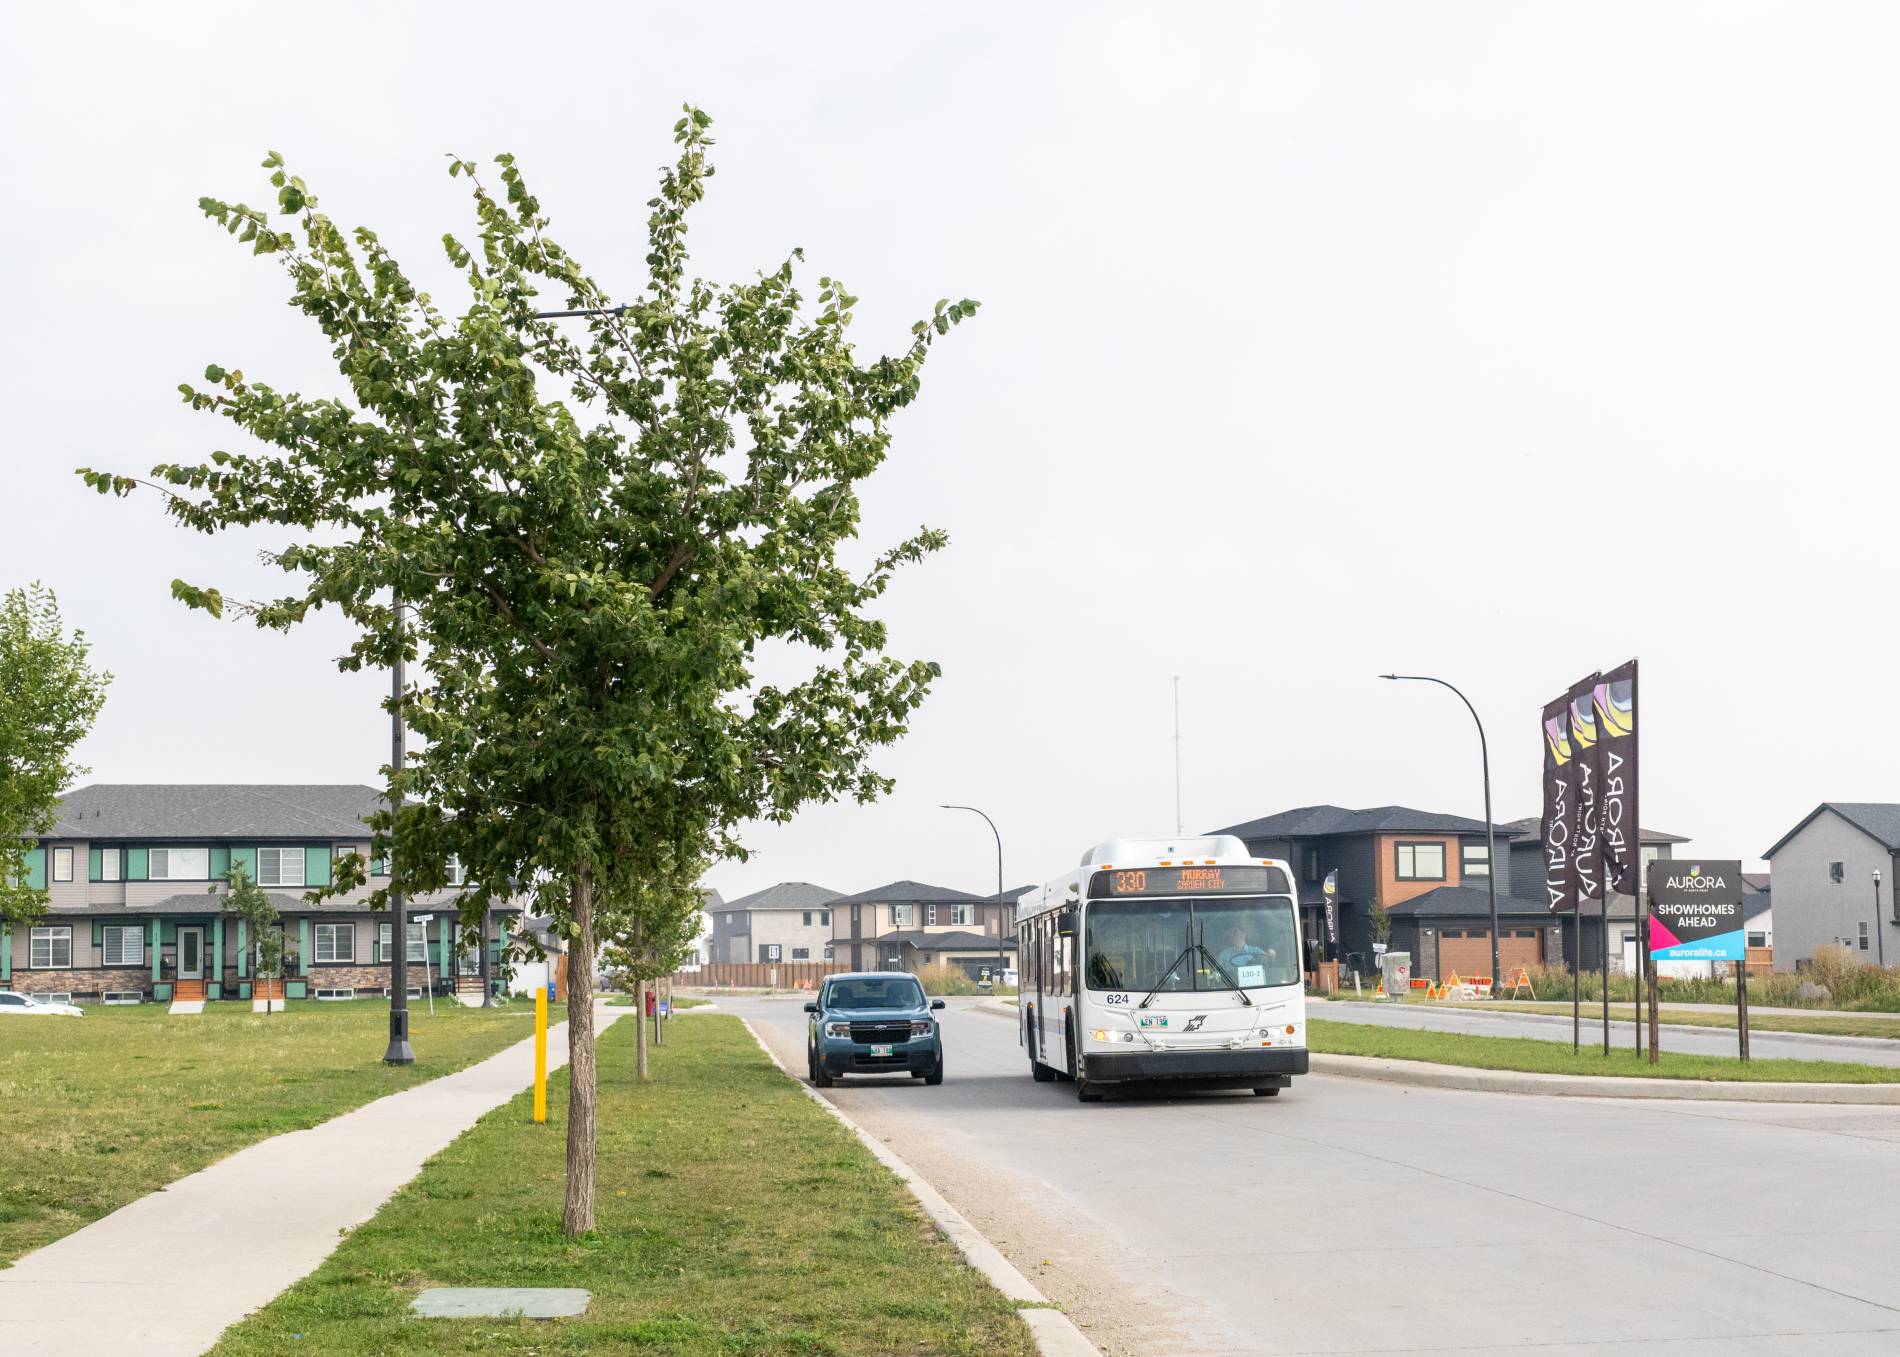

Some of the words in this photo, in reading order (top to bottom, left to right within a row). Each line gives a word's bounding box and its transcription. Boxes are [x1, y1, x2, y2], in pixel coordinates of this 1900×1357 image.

[1182, 869, 1220, 880] MURRAY
[1117, 872, 1146, 891] 330
[1177, 880, 1204, 889] GARDEN
[1209, 880, 1225, 888] CITY
[1666, 877, 1726, 888] AURORA
[1658, 905, 1734, 914] SHOWHOMES
[1678, 917, 1716, 927] AHEAD
[1669, 948, 1727, 957] auroralife.ca
[1107, 994, 1129, 1004] 624
